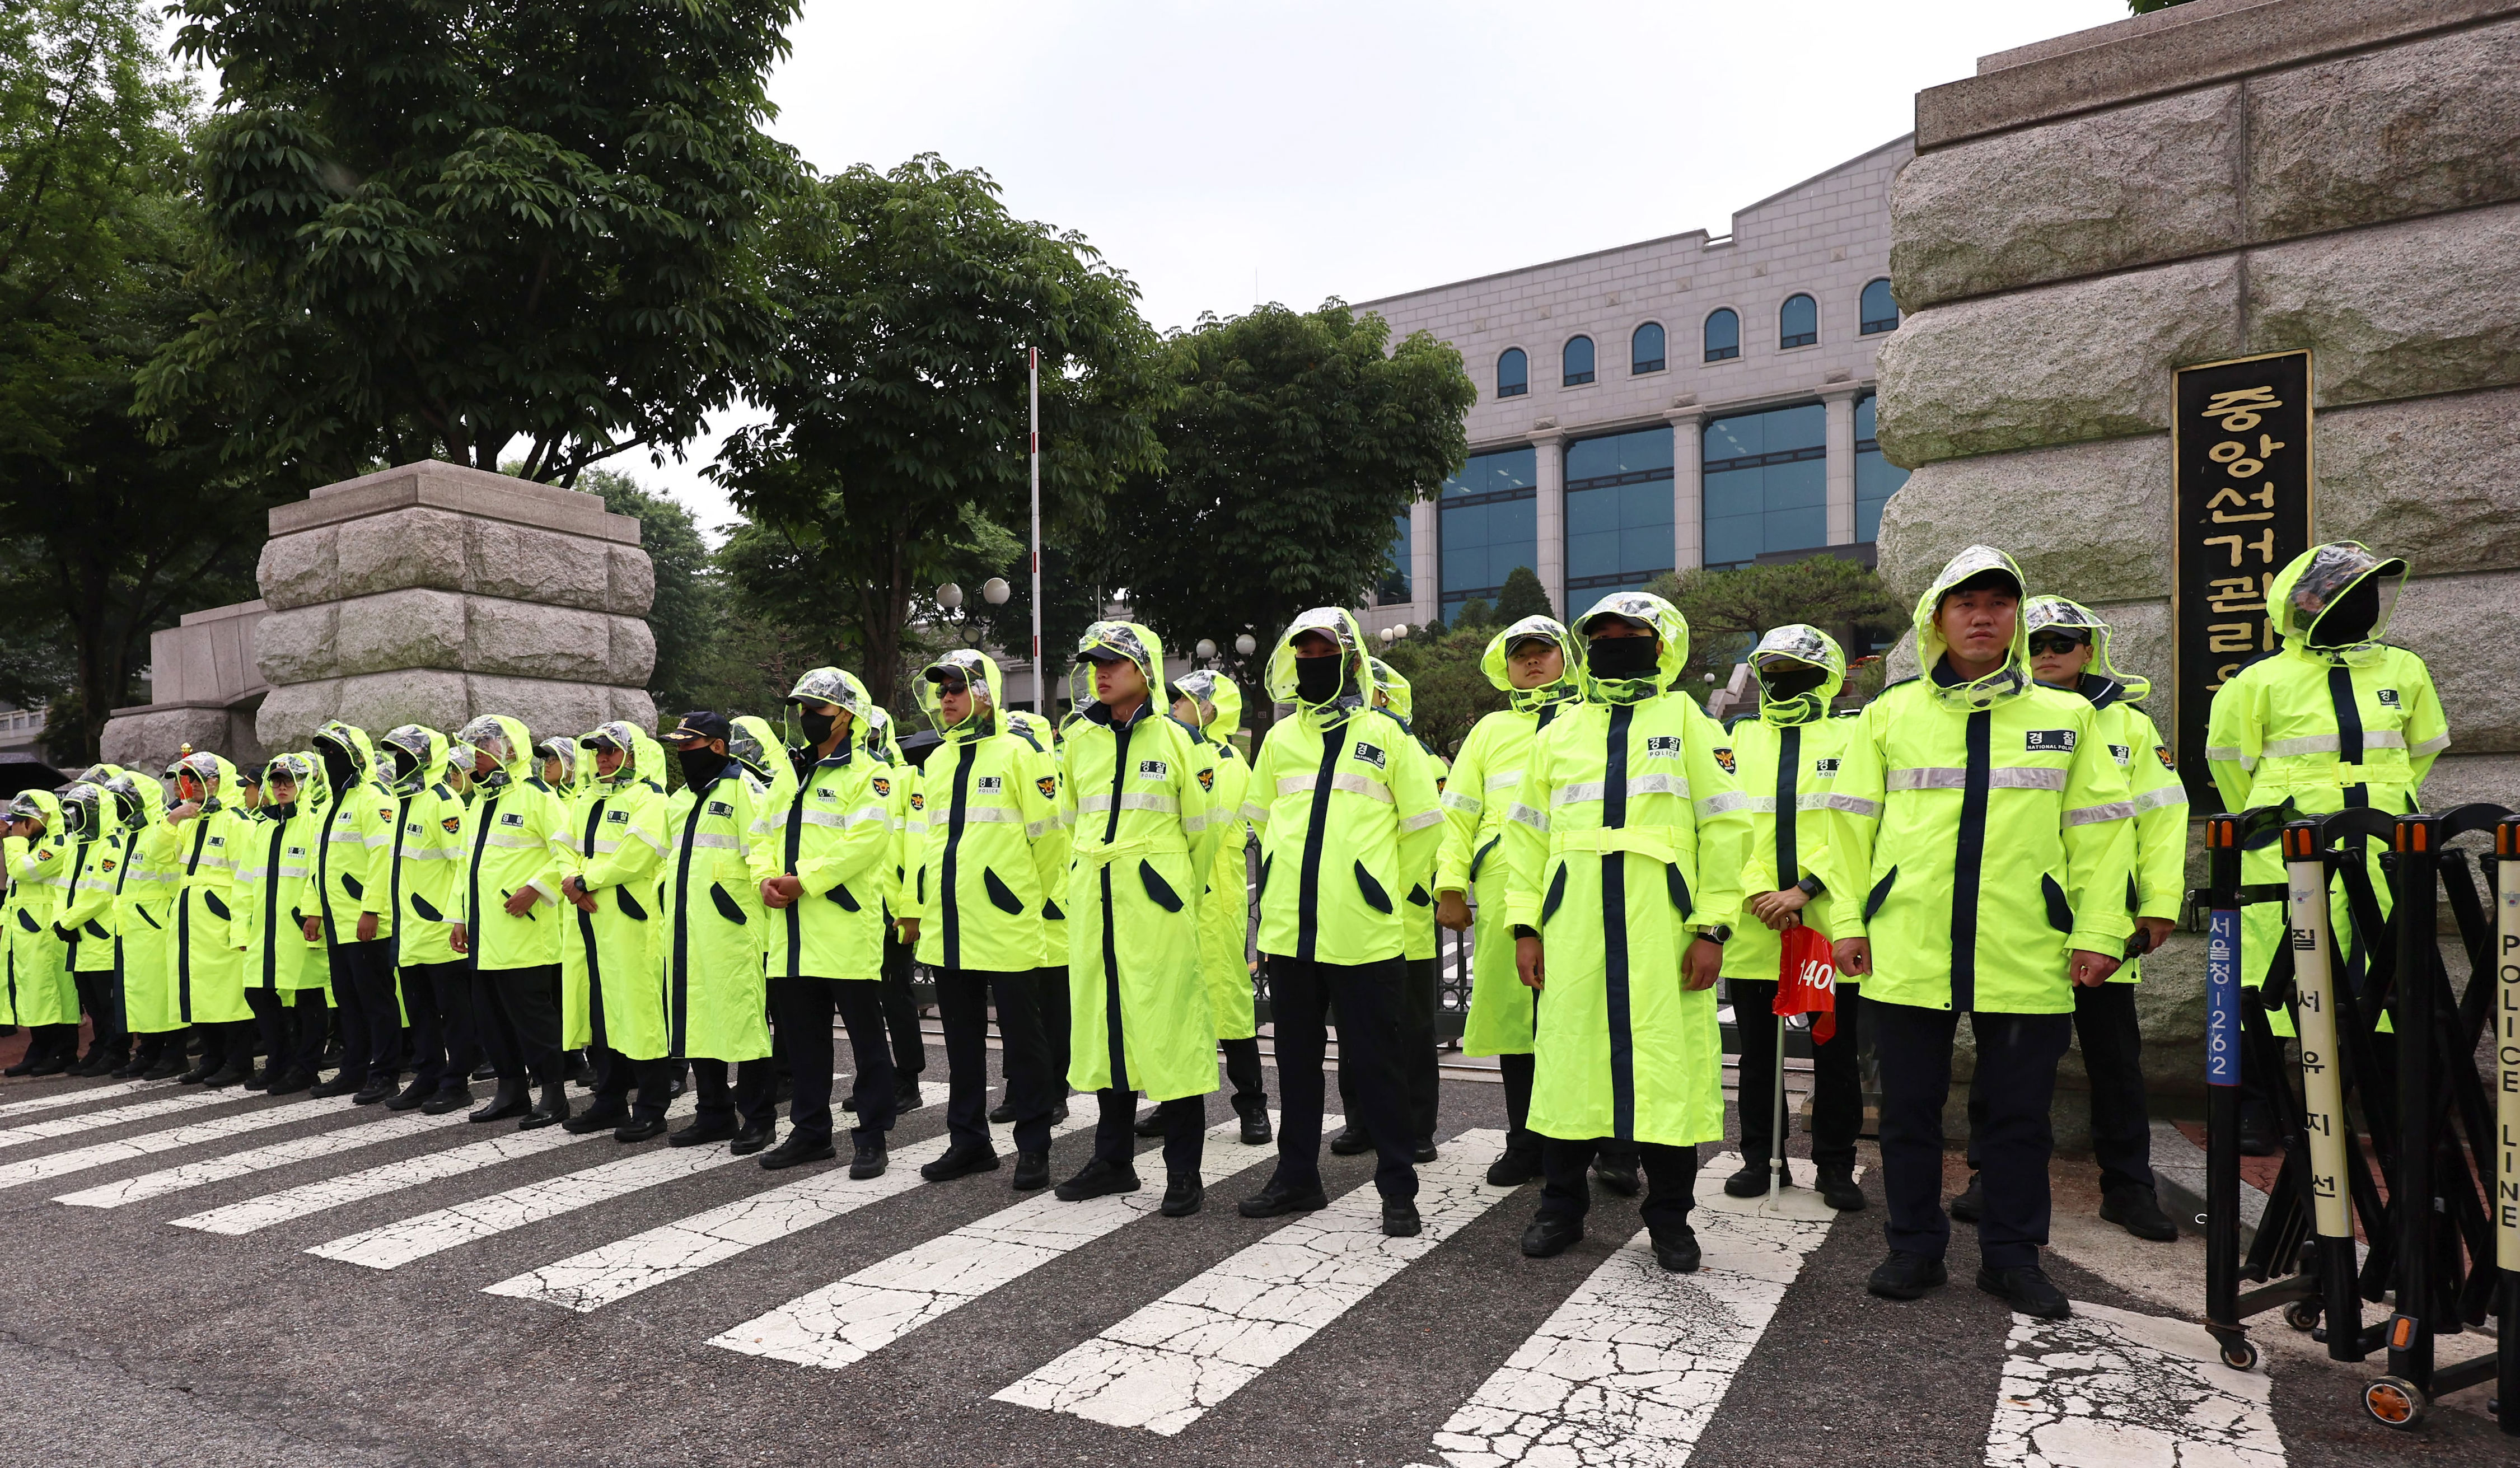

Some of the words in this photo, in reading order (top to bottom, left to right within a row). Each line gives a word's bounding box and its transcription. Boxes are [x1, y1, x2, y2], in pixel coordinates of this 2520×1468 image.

[2202, 385, 2286, 690] 중앙선거관리
[2379, 690, 2391, 701] 경
[1649, 737, 1679, 751] 경찰
[2029, 731, 2074, 746] 경찰
[1354, 754, 1374, 763] NATIONAL
[1358, 744, 1385, 764] 경찰
[1649, 750, 1677, 758] POLICE
[2116, 746, 2128, 758] 찰
[1142, 761, 1166, 774] 경찰
[979, 777, 1000, 787] 경찰
[2209, 917, 2231, 1076] 서울청-262
[2500, 934, 2520, 1093] POLICE
[2294, 929, 2336, 1197] 질서유지선
[2500, 1124, 2519, 1229] LINE
